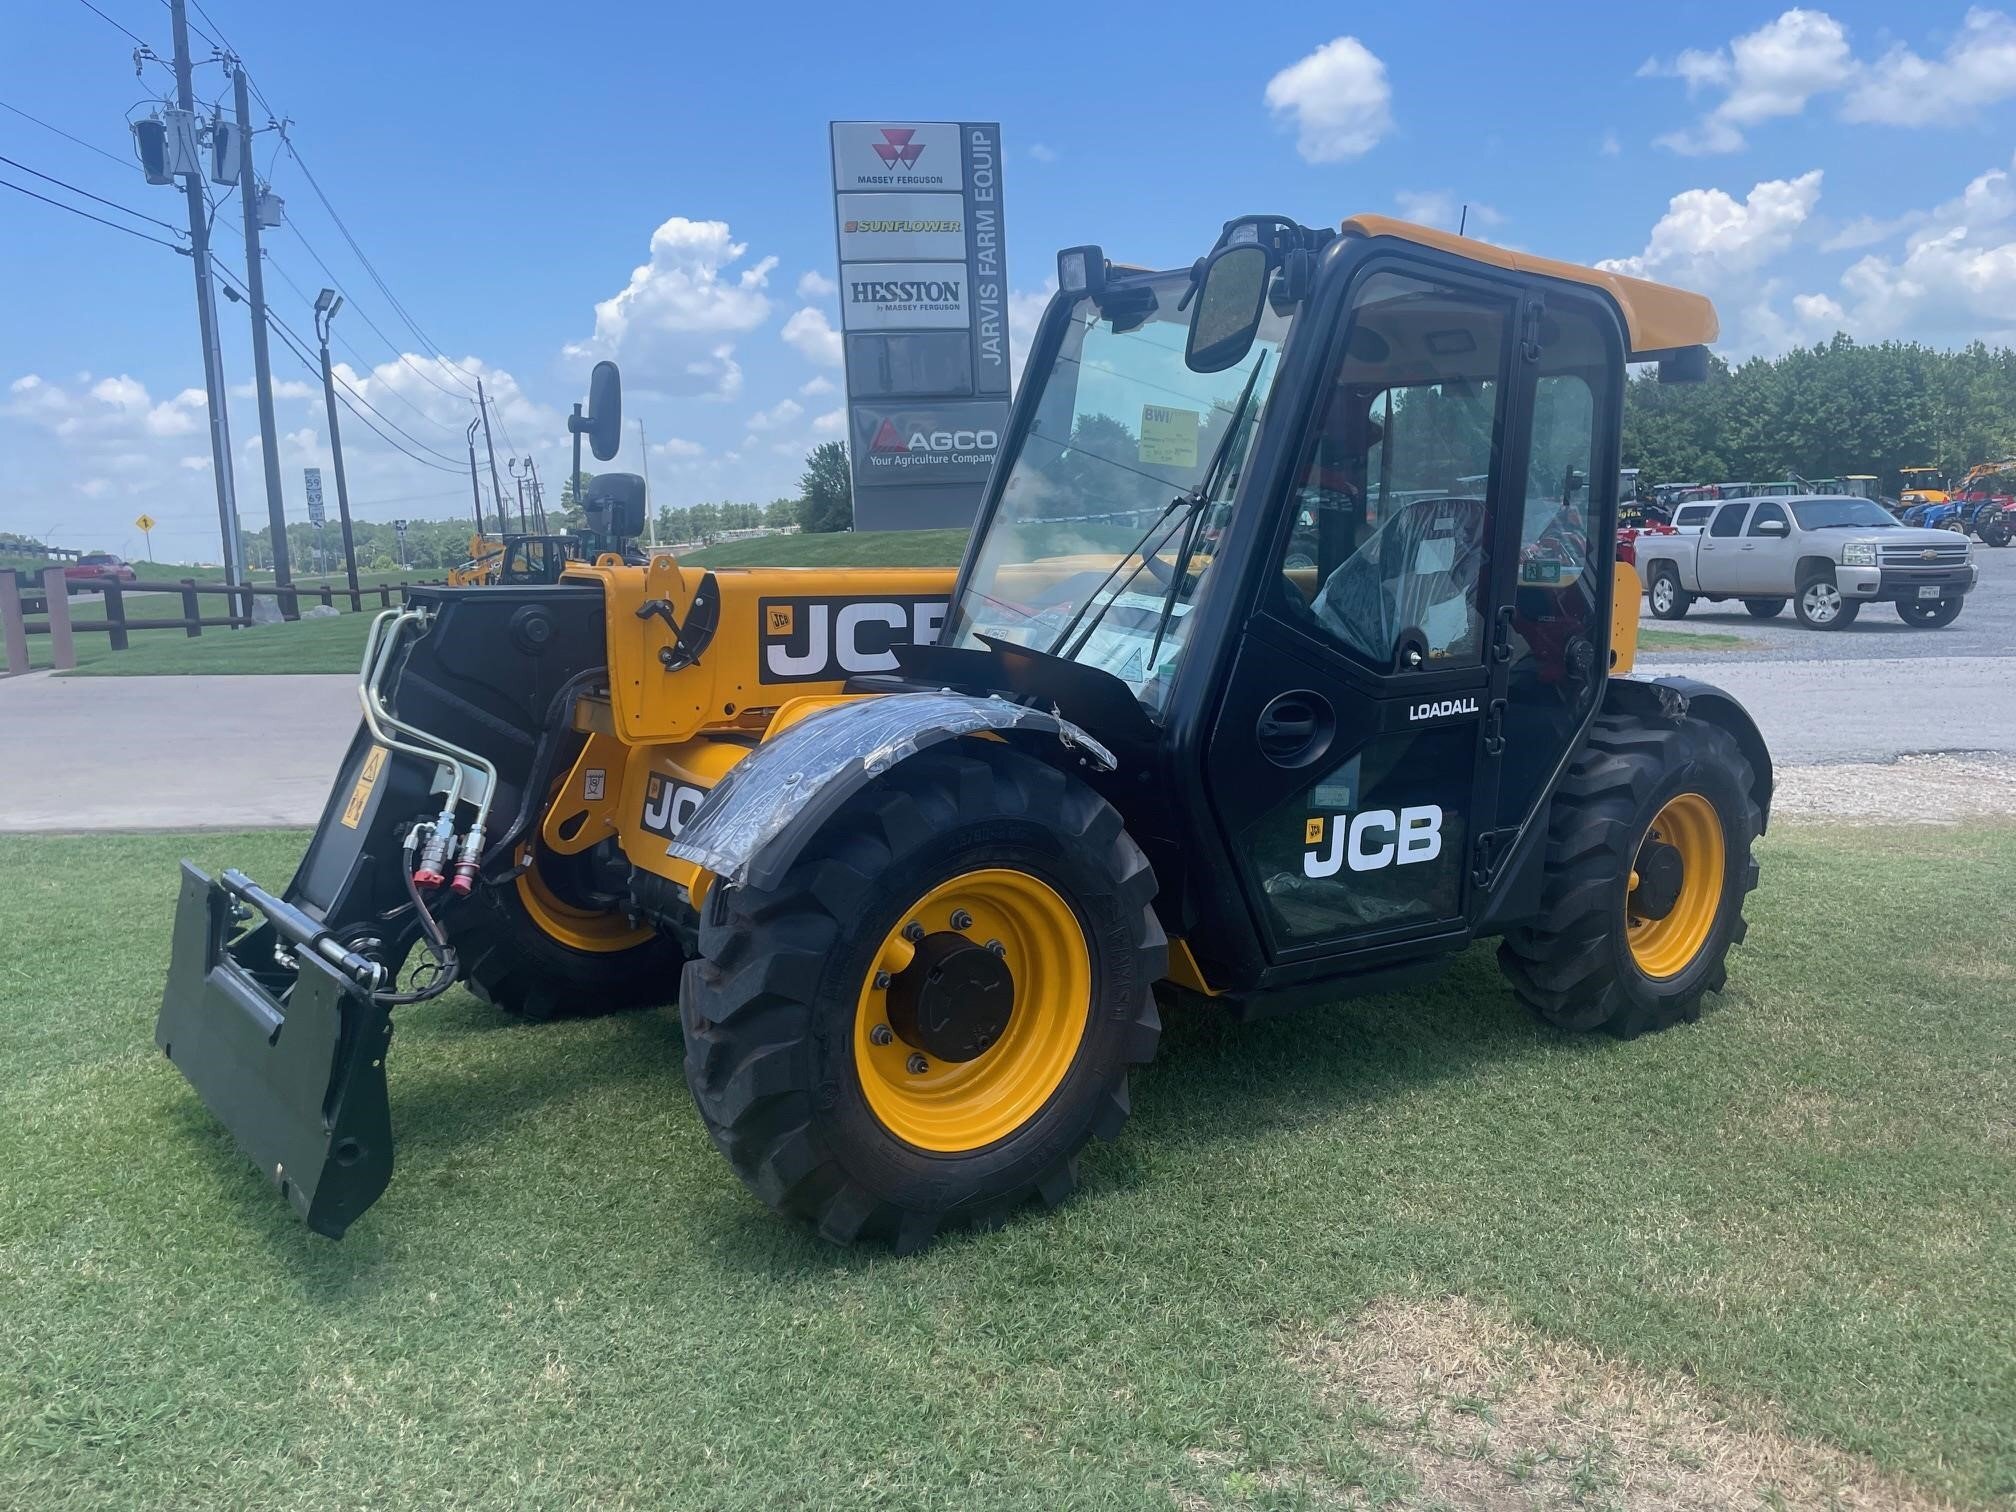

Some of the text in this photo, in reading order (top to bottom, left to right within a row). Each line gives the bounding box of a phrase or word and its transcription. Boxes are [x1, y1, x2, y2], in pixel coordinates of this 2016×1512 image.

[857, 176, 943, 184] MASSEY FERGUSON
[857, 220, 961, 233] SUNFLOWER
[972, 130, 1001, 365] JARVIS FARM EQUIP
[851, 281, 960, 303] HESSTON
[885, 304, 917, 312] MASSEY
[920, 303, 960, 312] FERGUSON
[908, 430, 998, 451] AGCO
[870, 453, 997, 467] Your Agriculture Company
[306, 478, 320, 488] 59
[309, 493, 321, 503] 69
[1409, 698, 1479, 721] LOADALL
[1303, 804, 1443, 879] JCB
